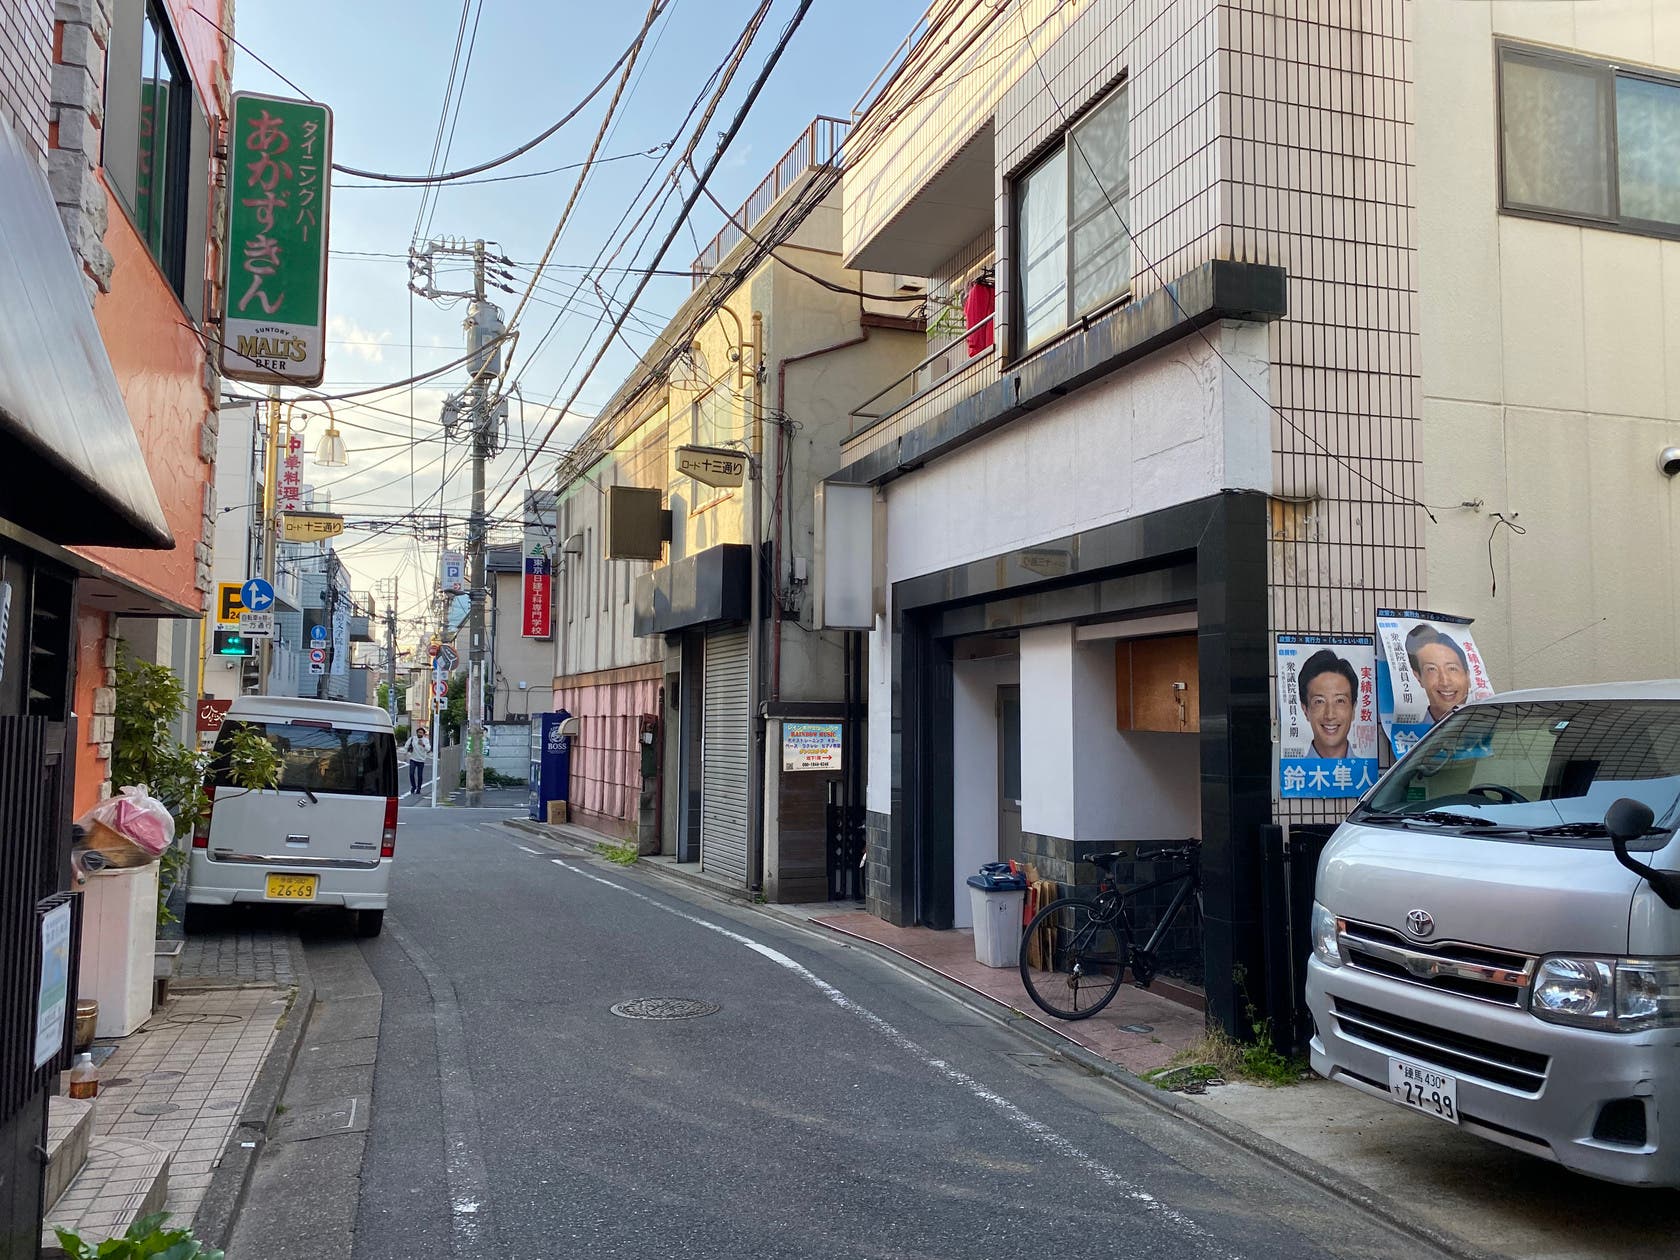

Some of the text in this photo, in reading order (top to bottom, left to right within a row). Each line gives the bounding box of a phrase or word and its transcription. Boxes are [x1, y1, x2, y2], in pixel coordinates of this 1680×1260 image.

[296, 120, 319, 242] ダイニングバー
[239, 109, 294, 314] あかずきん
[255, 327, 290, 336] SUNTORY
[236, 335, 307, 362] MALT'S
[256, 359, 286, 370] BEER
[1361, 666, 1373, 721] 実績多数
[1283, 765, 1374, 791] 鈴木隼人
[277, 885, 312, 897] 26-69
[1404, 1066, 1441, 1089] 練馬 430
[1403, 1081, 1454, 1119] 27-99
